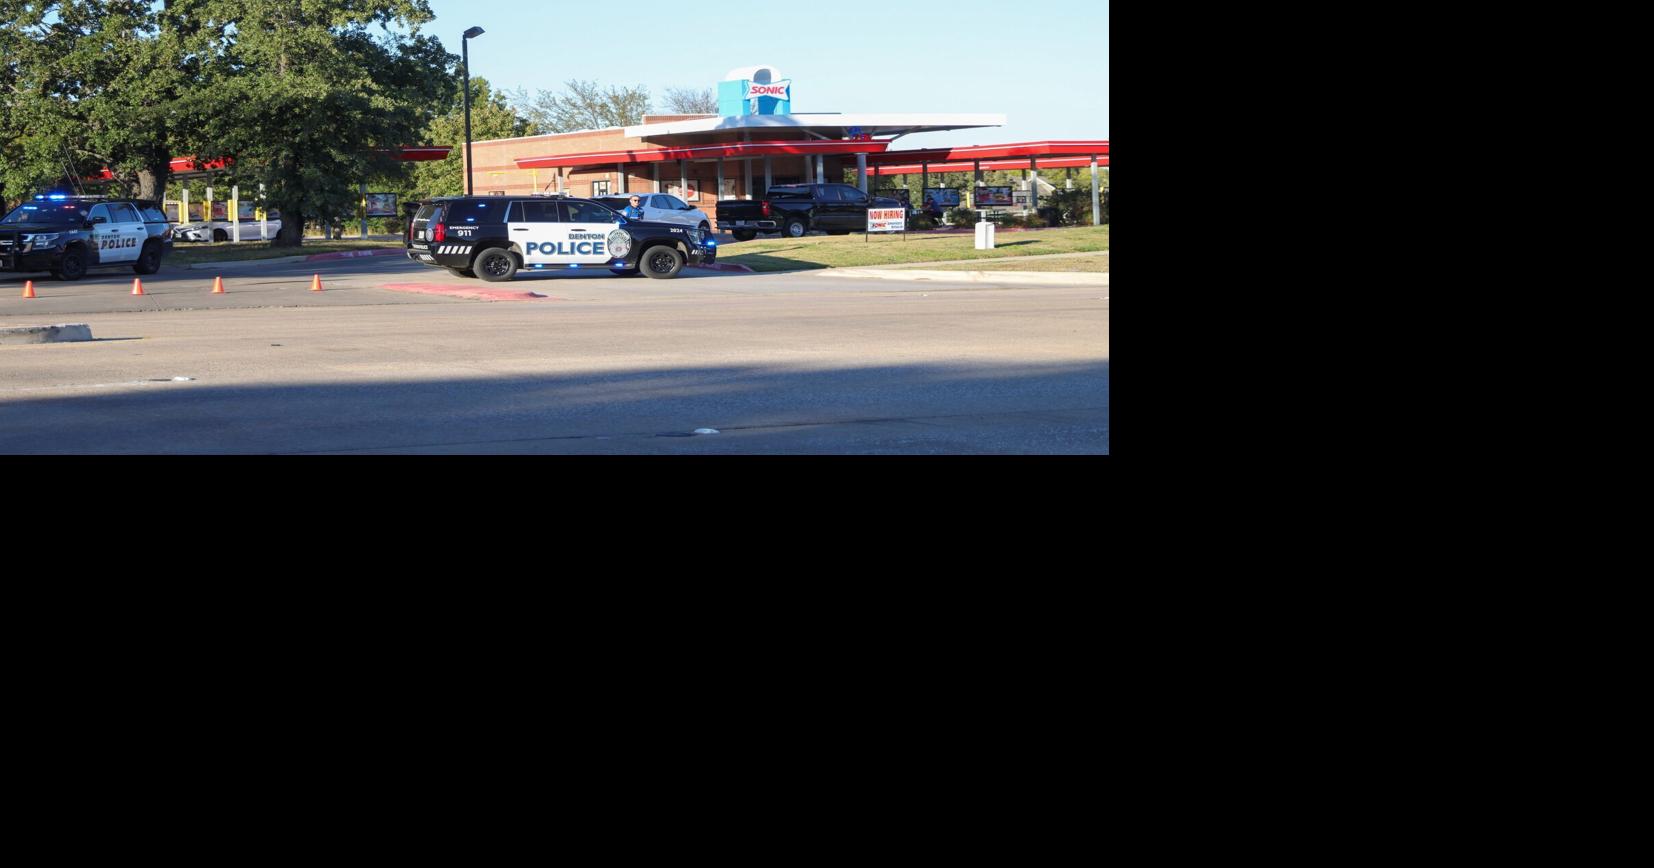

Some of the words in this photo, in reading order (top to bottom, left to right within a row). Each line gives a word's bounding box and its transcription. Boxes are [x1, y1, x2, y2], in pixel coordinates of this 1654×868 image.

[750, 86, 785, 94] SONIC
[870, 210, 882, 219] NOW
[884, 210, 903, 219] HIRING
[101, 238, 137, 250] POLICE
[526, 242, 605, 255] POLICE
